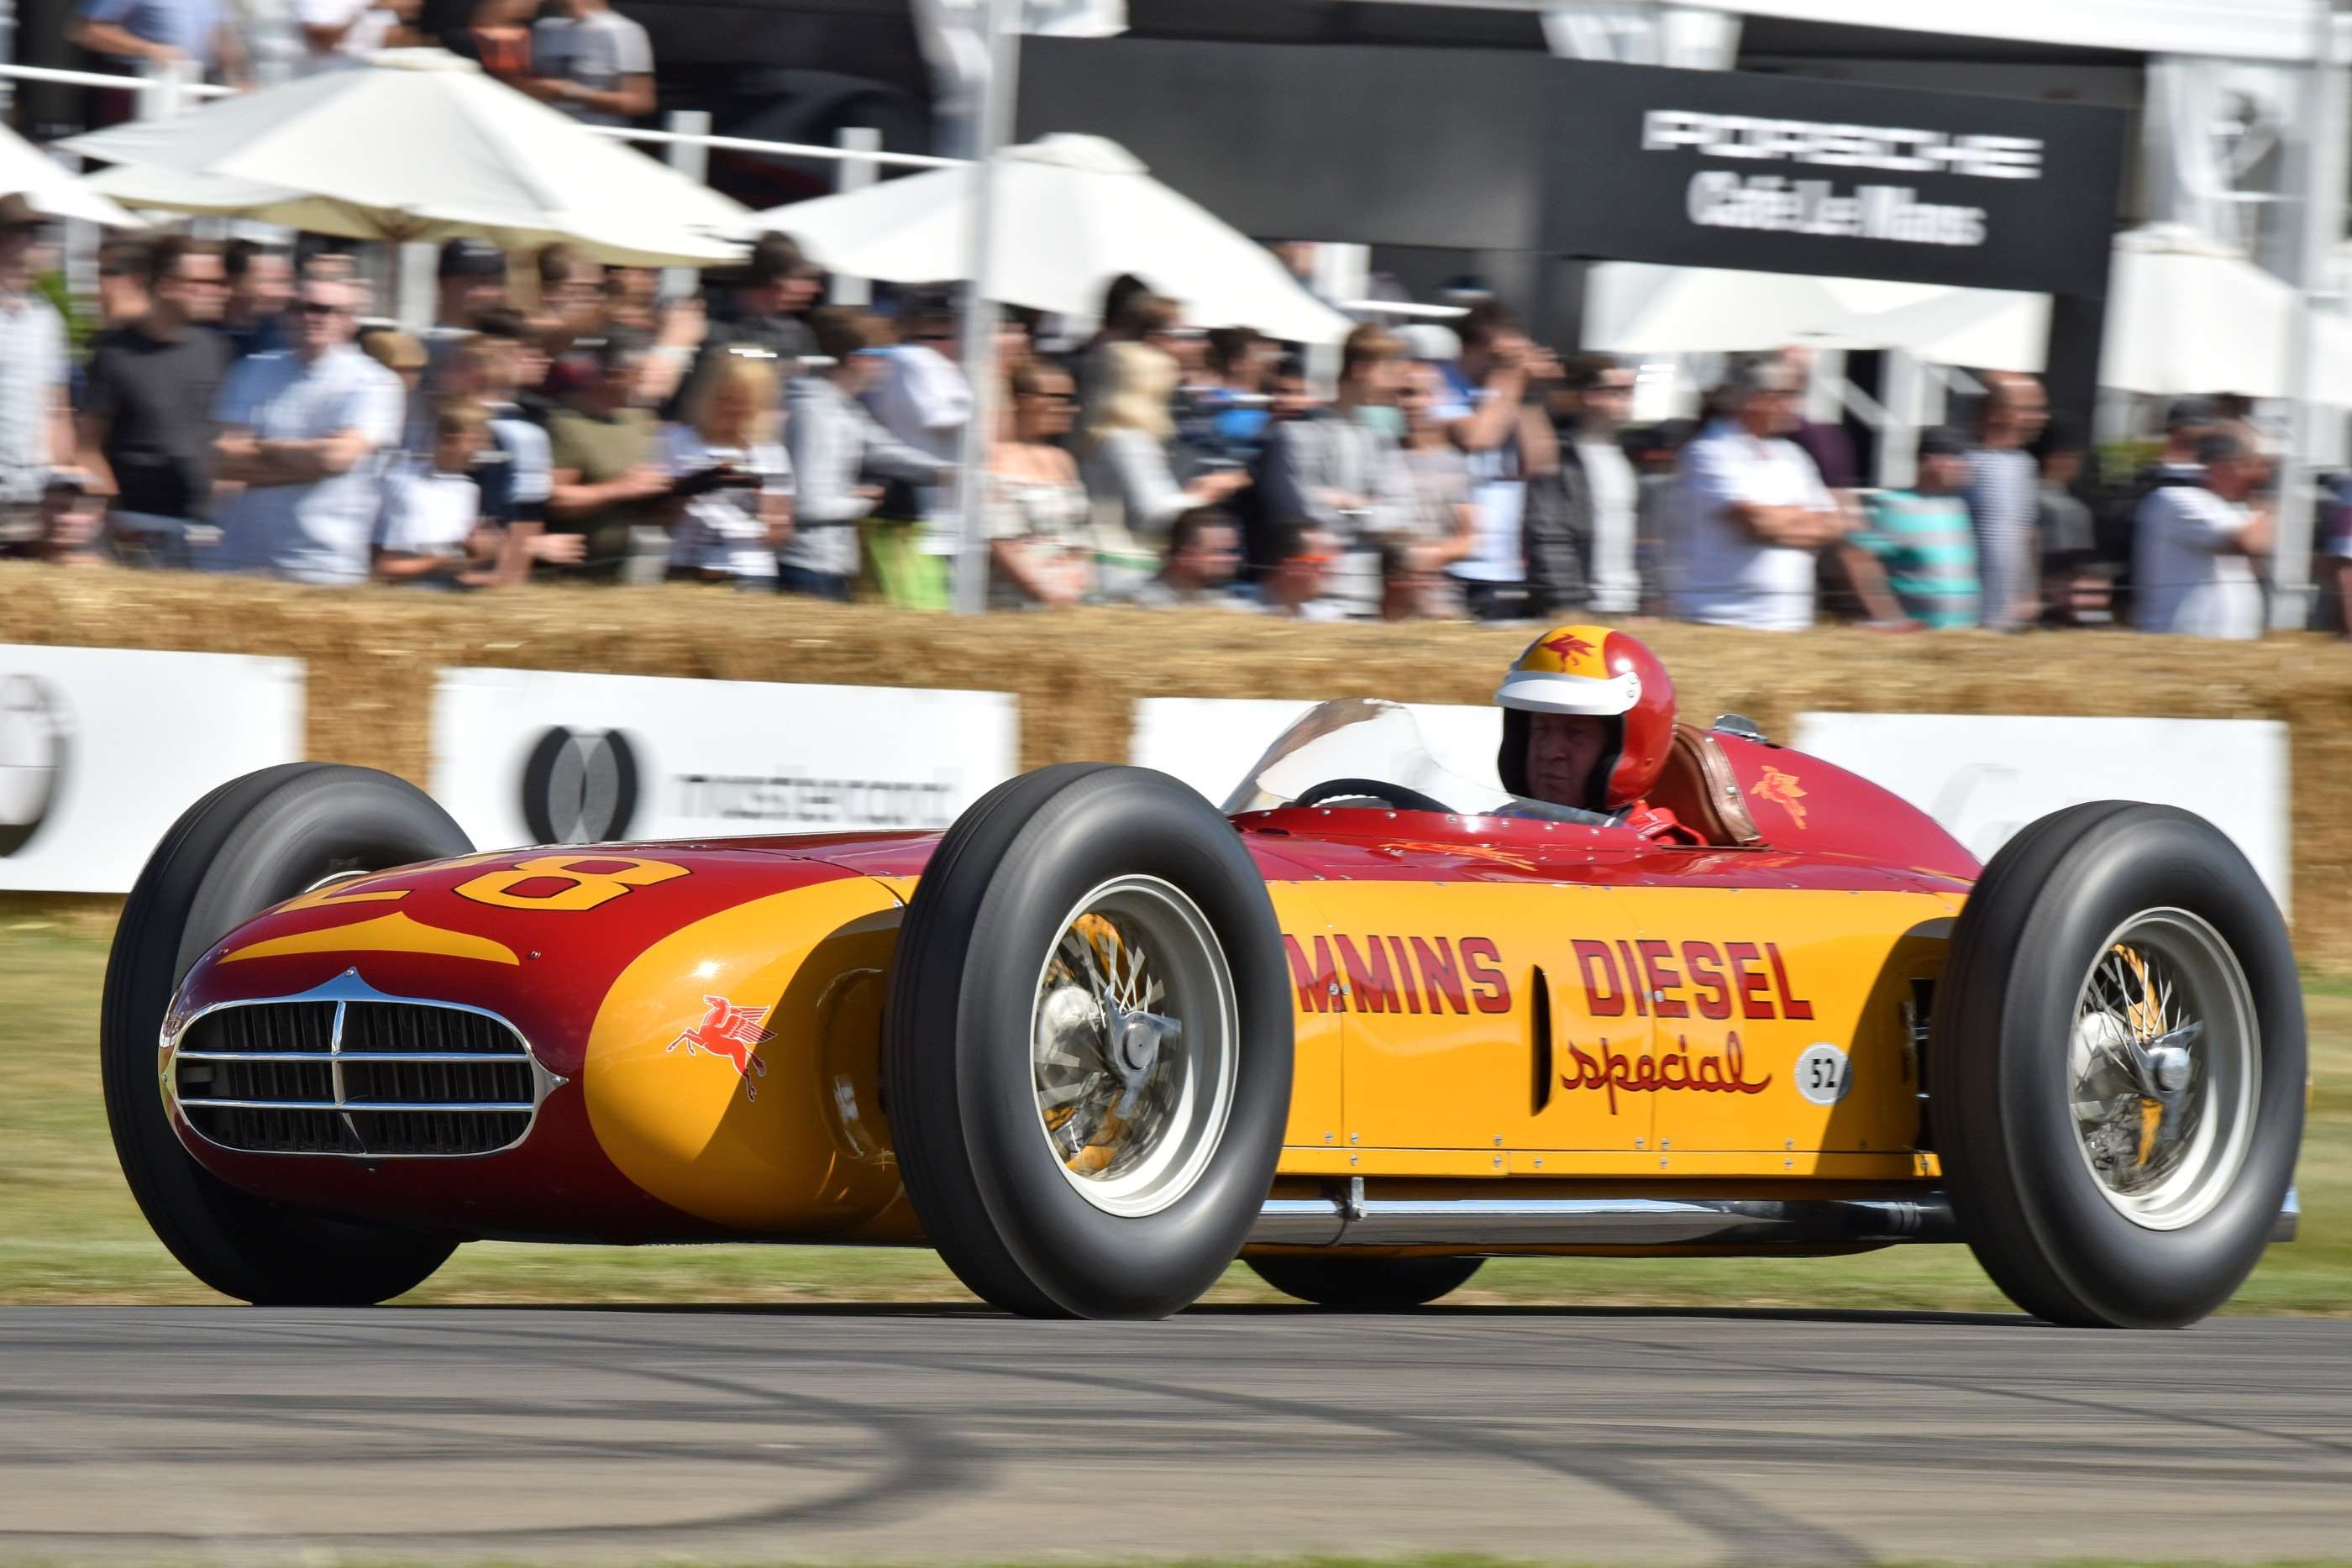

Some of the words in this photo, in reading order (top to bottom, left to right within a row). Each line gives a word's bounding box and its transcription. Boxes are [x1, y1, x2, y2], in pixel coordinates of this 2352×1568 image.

[1641, 109, 2045, 179] PORSCHE
[1281, 933, 1512, 1015] MMINS
[1570, 939, 1815, 1020] DIESEL
[1560, 1030, 1772, 1115] special
[1809, 1057, 1838, 1088] 52
